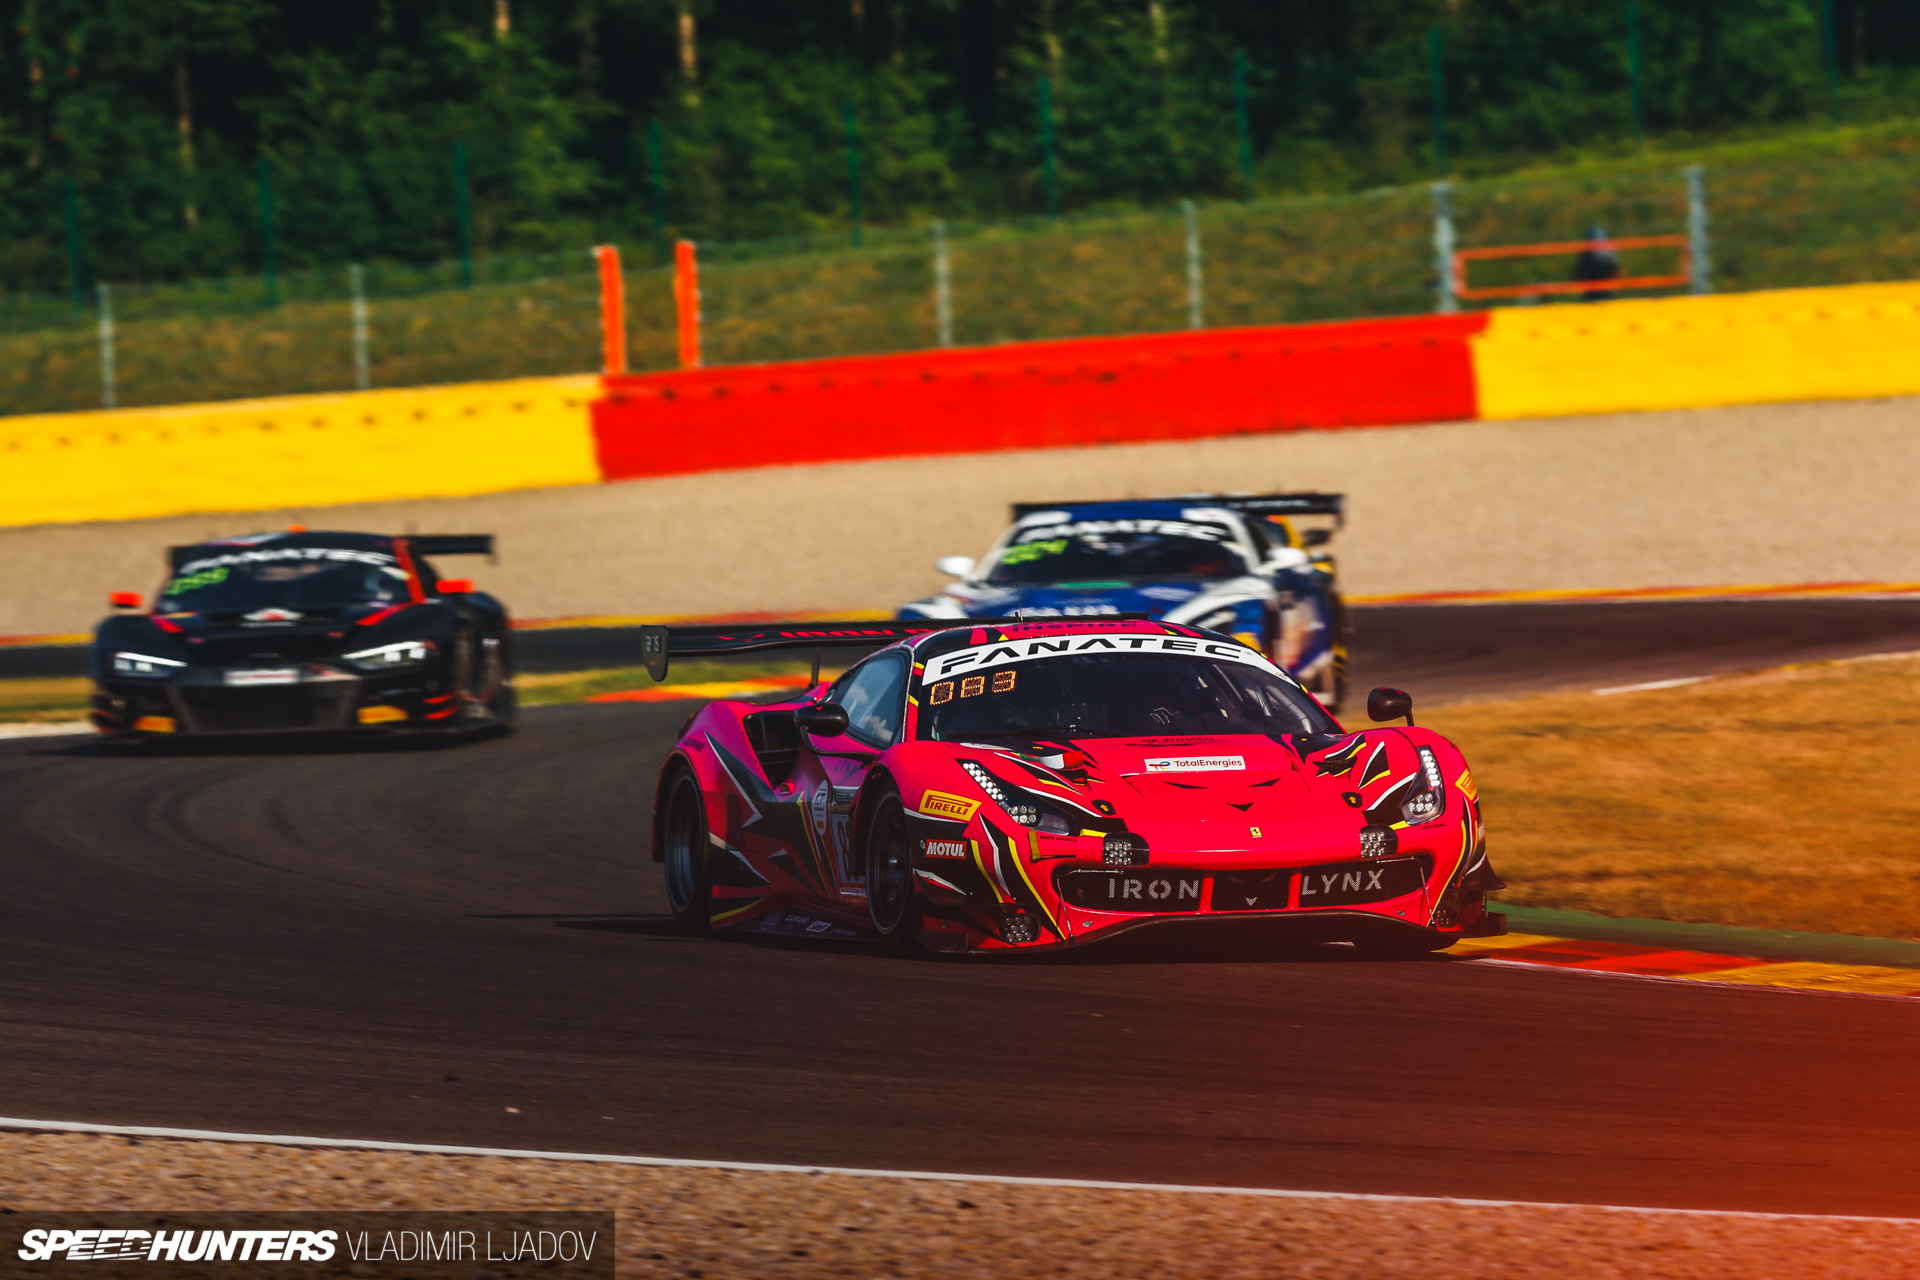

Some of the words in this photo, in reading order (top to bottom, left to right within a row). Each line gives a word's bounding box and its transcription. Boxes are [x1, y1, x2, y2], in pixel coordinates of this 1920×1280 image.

[940, 638, 1242, 675] FANATEC
[929, 670, 1017, 706] 083
[1173, 758, 1243, 768] TotalEnergies
[924, 794, 973, 816] PIRELLI
[926, 841, 966, 857] MOTUL
[1108, 877, 1200, 900] IRON
[1301, 868, 1385, 896] LYNX
